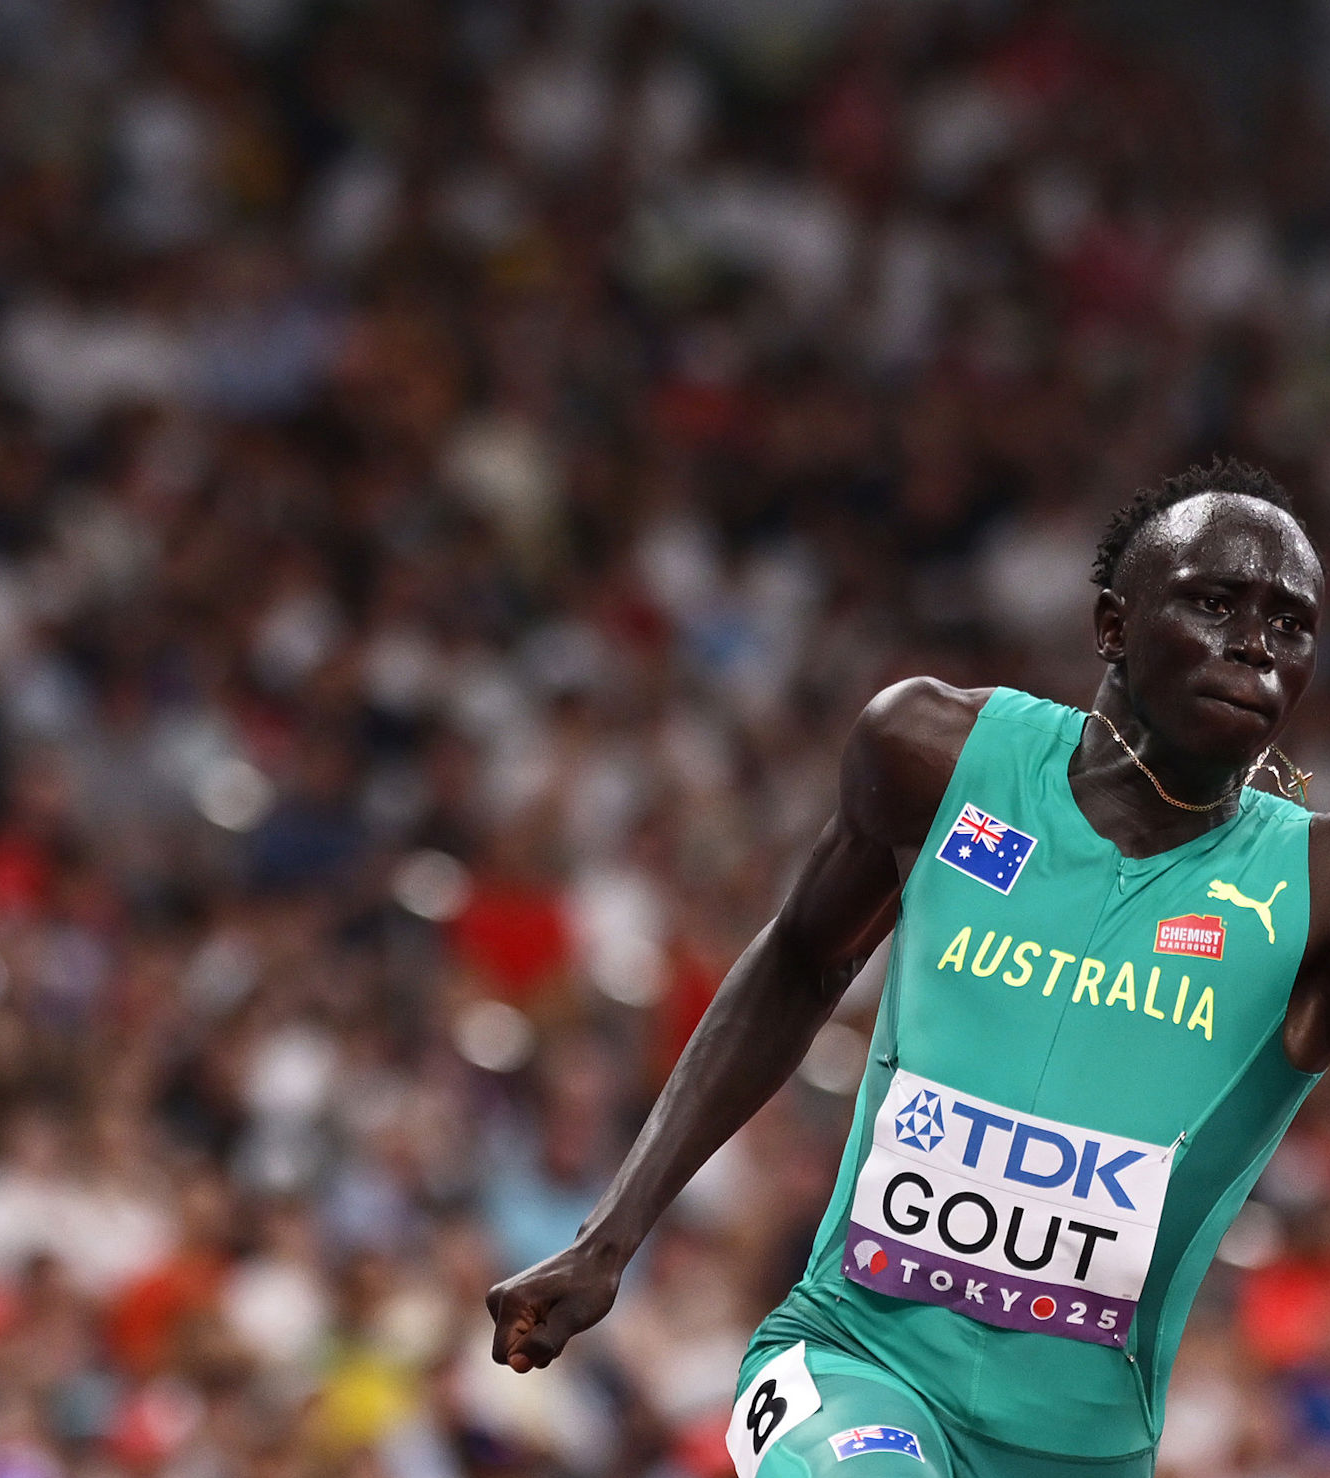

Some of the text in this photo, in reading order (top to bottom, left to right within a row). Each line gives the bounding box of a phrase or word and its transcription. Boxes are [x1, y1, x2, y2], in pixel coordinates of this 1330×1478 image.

[1159, 940, 1218, 954] WAREHOUSE
[1160, 926, 1221, 945] CHEMIST
[936, 925, 1217, 1042] AUSTRALIA
[950, 1102, 1148, 1211] TDK
[881, 1170, 1120, 1282] GOUT
[746, 1378, 788, 1456] 8
